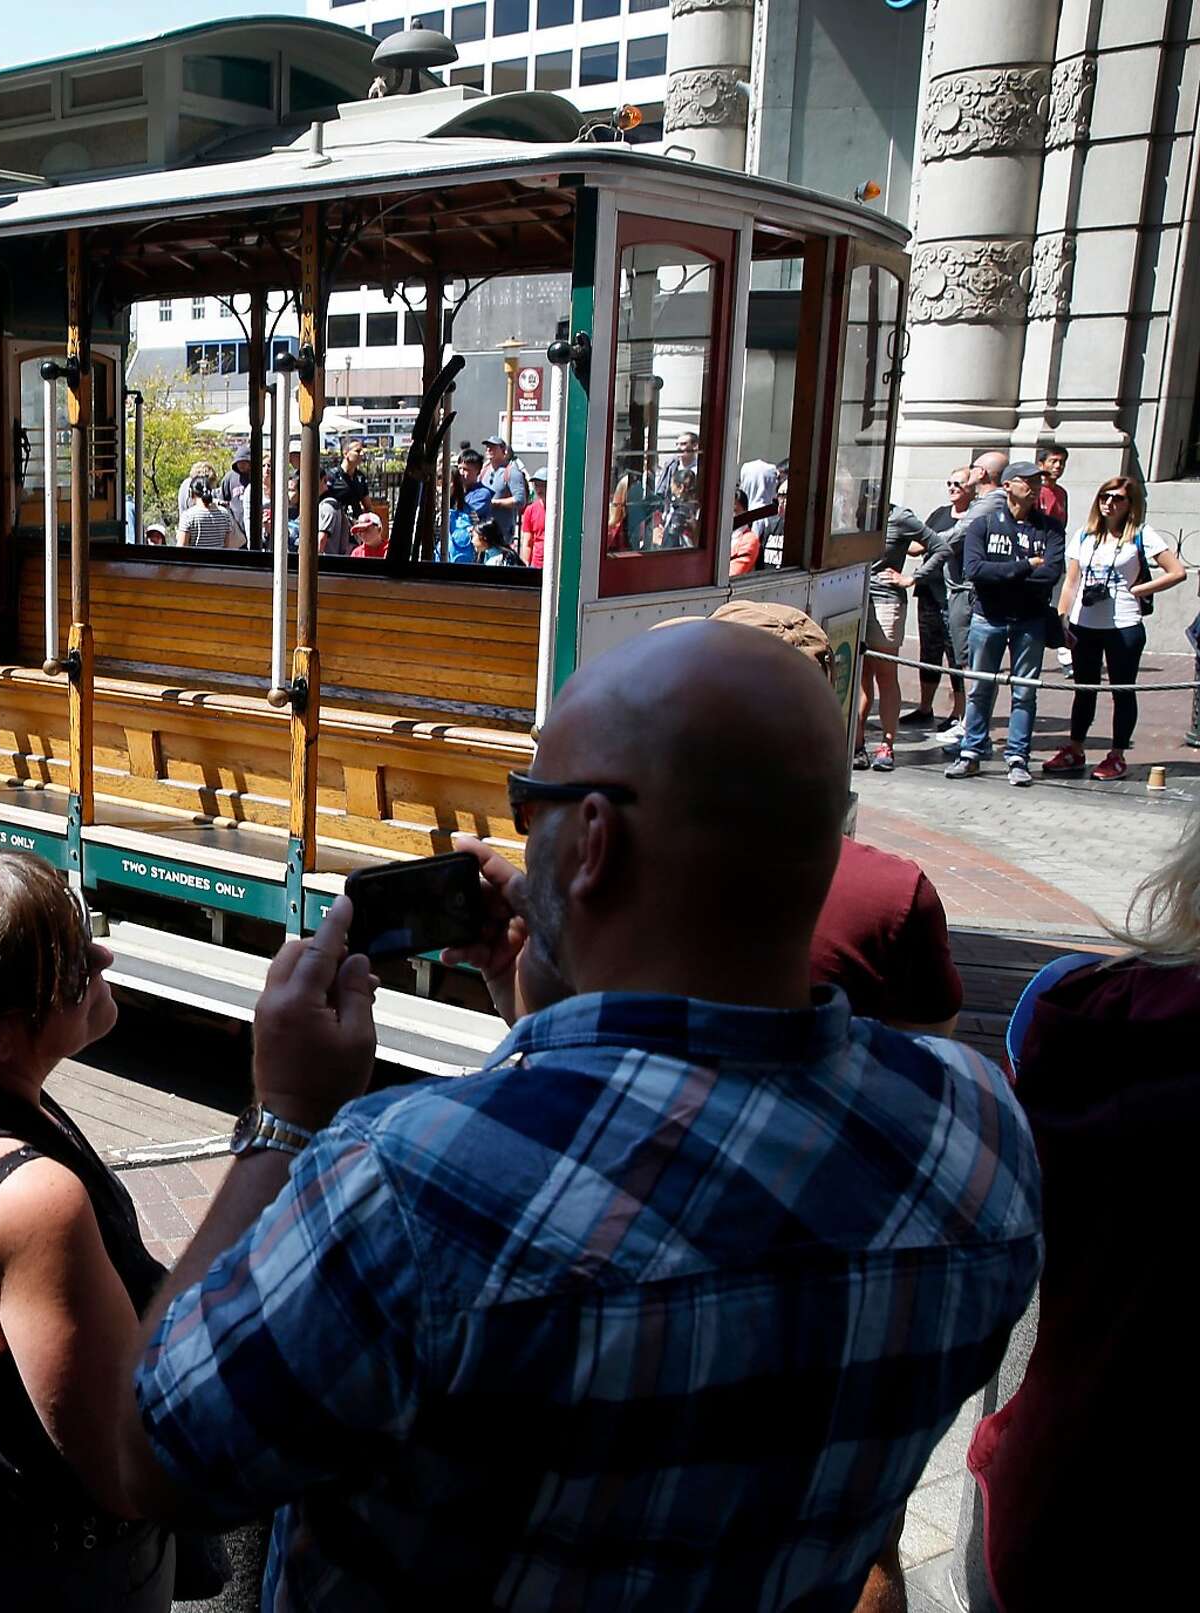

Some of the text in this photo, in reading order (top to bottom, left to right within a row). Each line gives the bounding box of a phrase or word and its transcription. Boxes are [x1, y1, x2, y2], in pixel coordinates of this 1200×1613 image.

[10, 834, 35, 850] ONLY
[121, 859, 246, 899] TWO STANDEES ONLY
